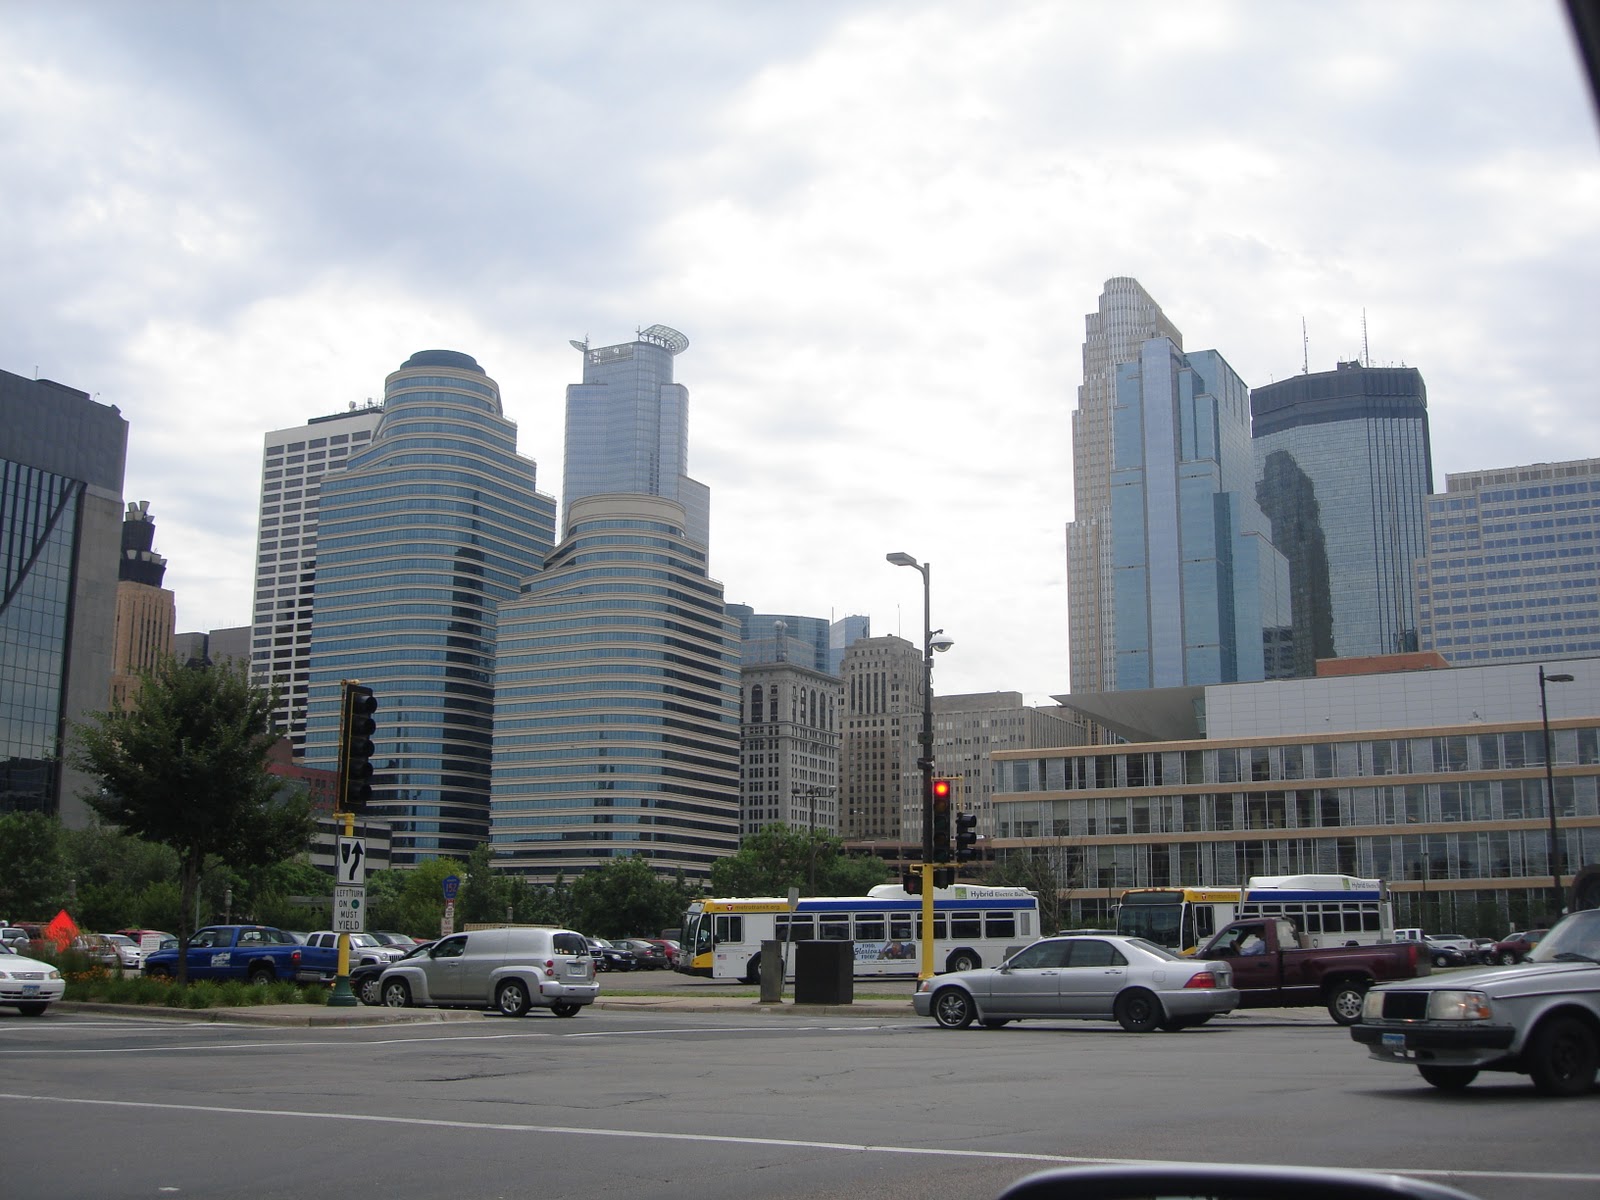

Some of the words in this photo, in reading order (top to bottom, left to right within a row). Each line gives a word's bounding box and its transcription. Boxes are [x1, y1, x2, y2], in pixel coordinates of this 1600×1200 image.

[336, 889, 349, 897] LEFT
[351, 889, 363, 898] TURN
[970, 890, 993, 899] Hybrid
[339, 900, 348, 908] ON
[338, 920, 360, 930] YIELD
